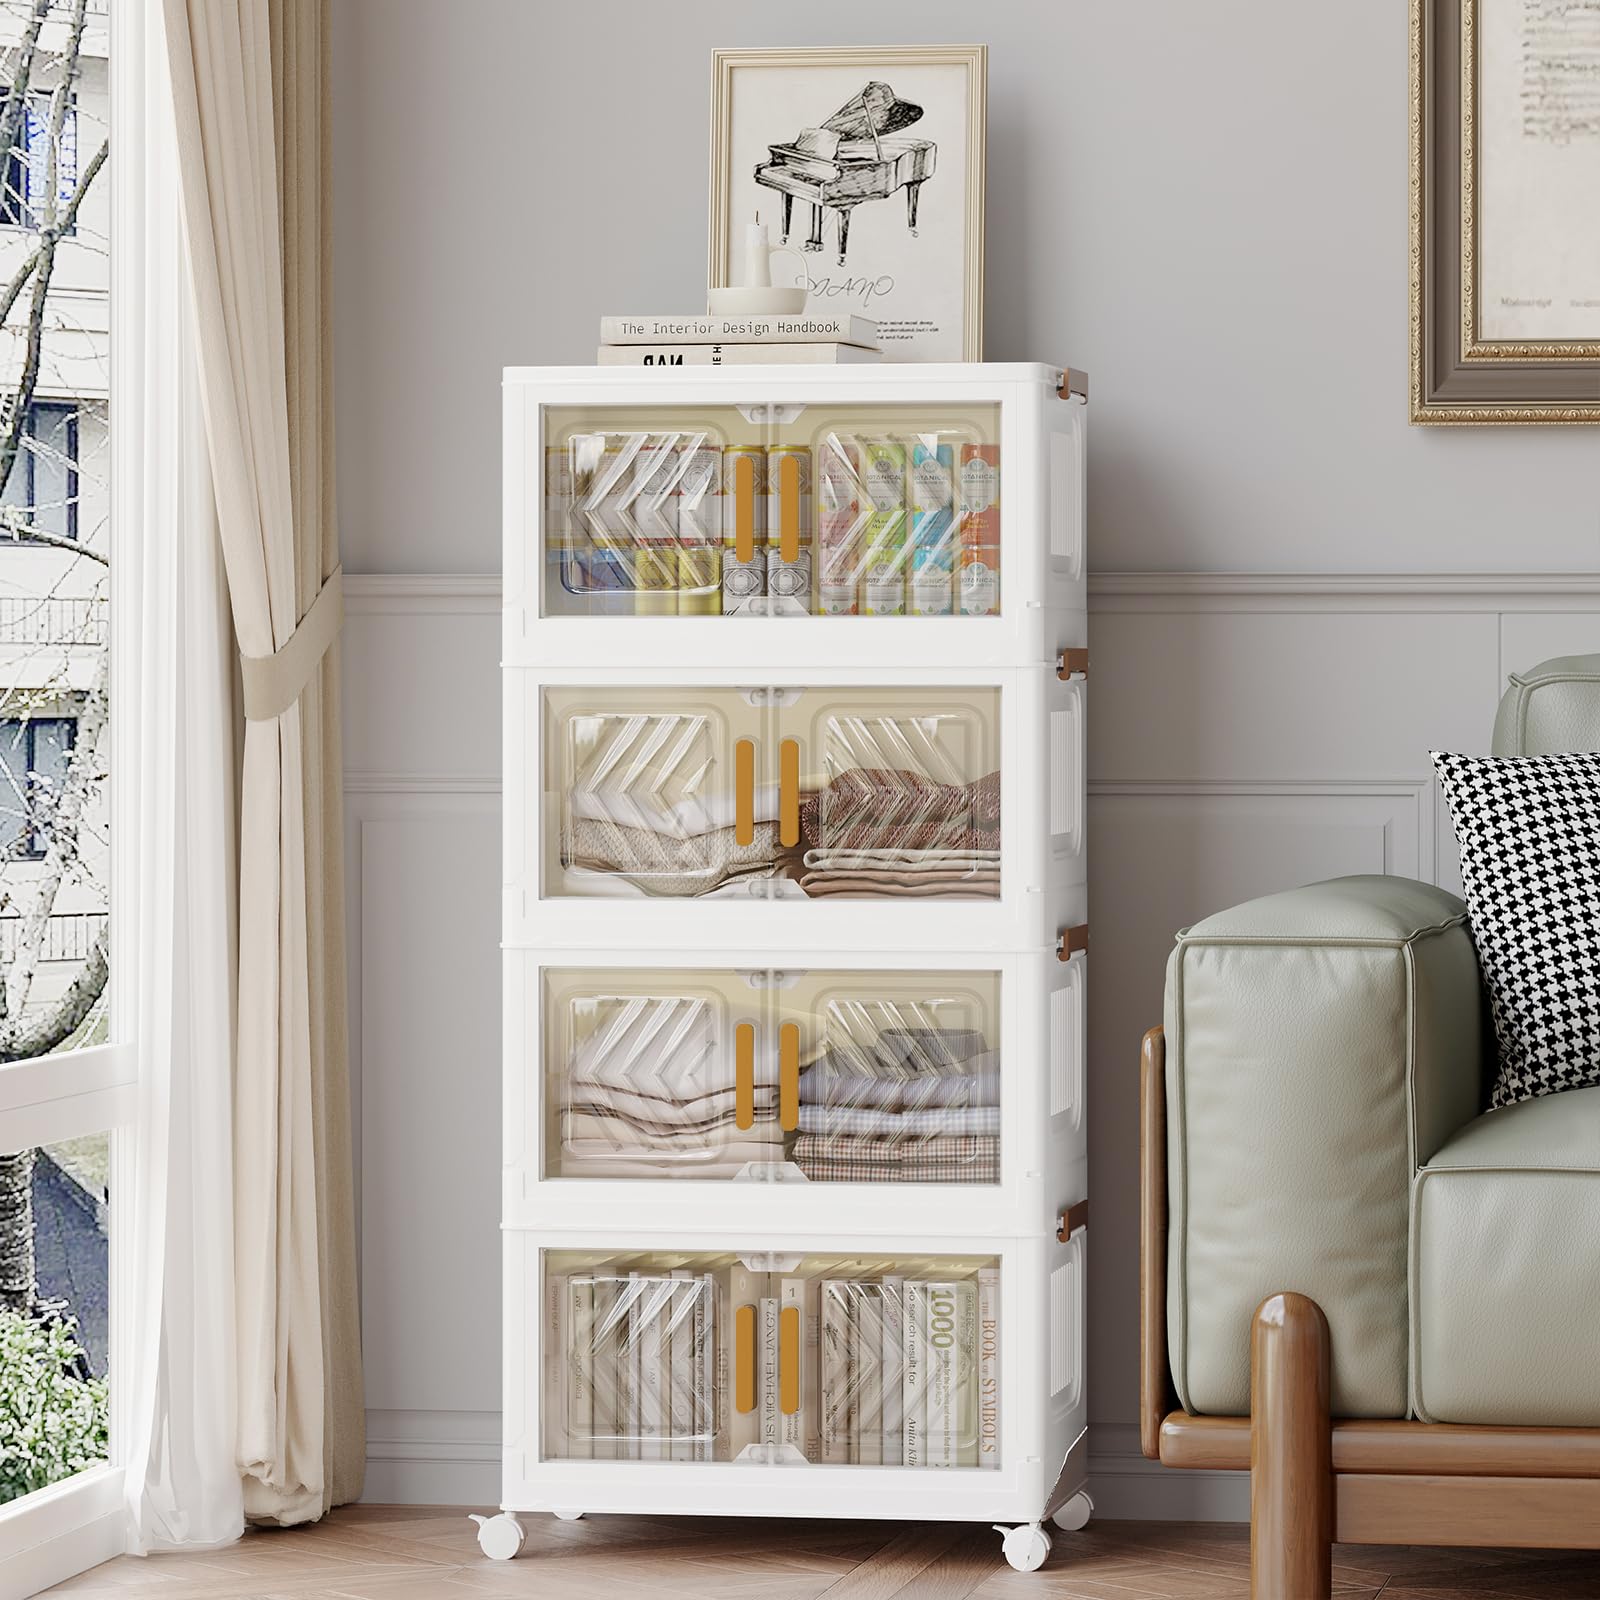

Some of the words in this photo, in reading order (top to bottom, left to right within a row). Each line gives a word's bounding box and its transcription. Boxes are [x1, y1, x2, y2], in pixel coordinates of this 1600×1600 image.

[621, 323, 645, 334] The
[653, 322, 715, 334] Interior
[723, 321, 770, 337] Design
[777, 320, 840, 334] Handbook
[908, 1303, 917, 1338] search
[931, 1289, 955, 1349] 1000
[981, 1301, 990, 1315] THE
[766, 1311, 775, 1357] JANG?
[981, 1319, 997, 1361] BOOK
[908, 1340, 917, 1368] result
[908, 1371, 917, 1386] for
[981, 1364, 990, 1376] OF
[766, 1362, 775, 1421] MICHAEL
[981, 1377, 997, 1453] SYMBOLS
[766, 1424, 775, 1437] IS
[908, 1417, 918, 1446] Anita
